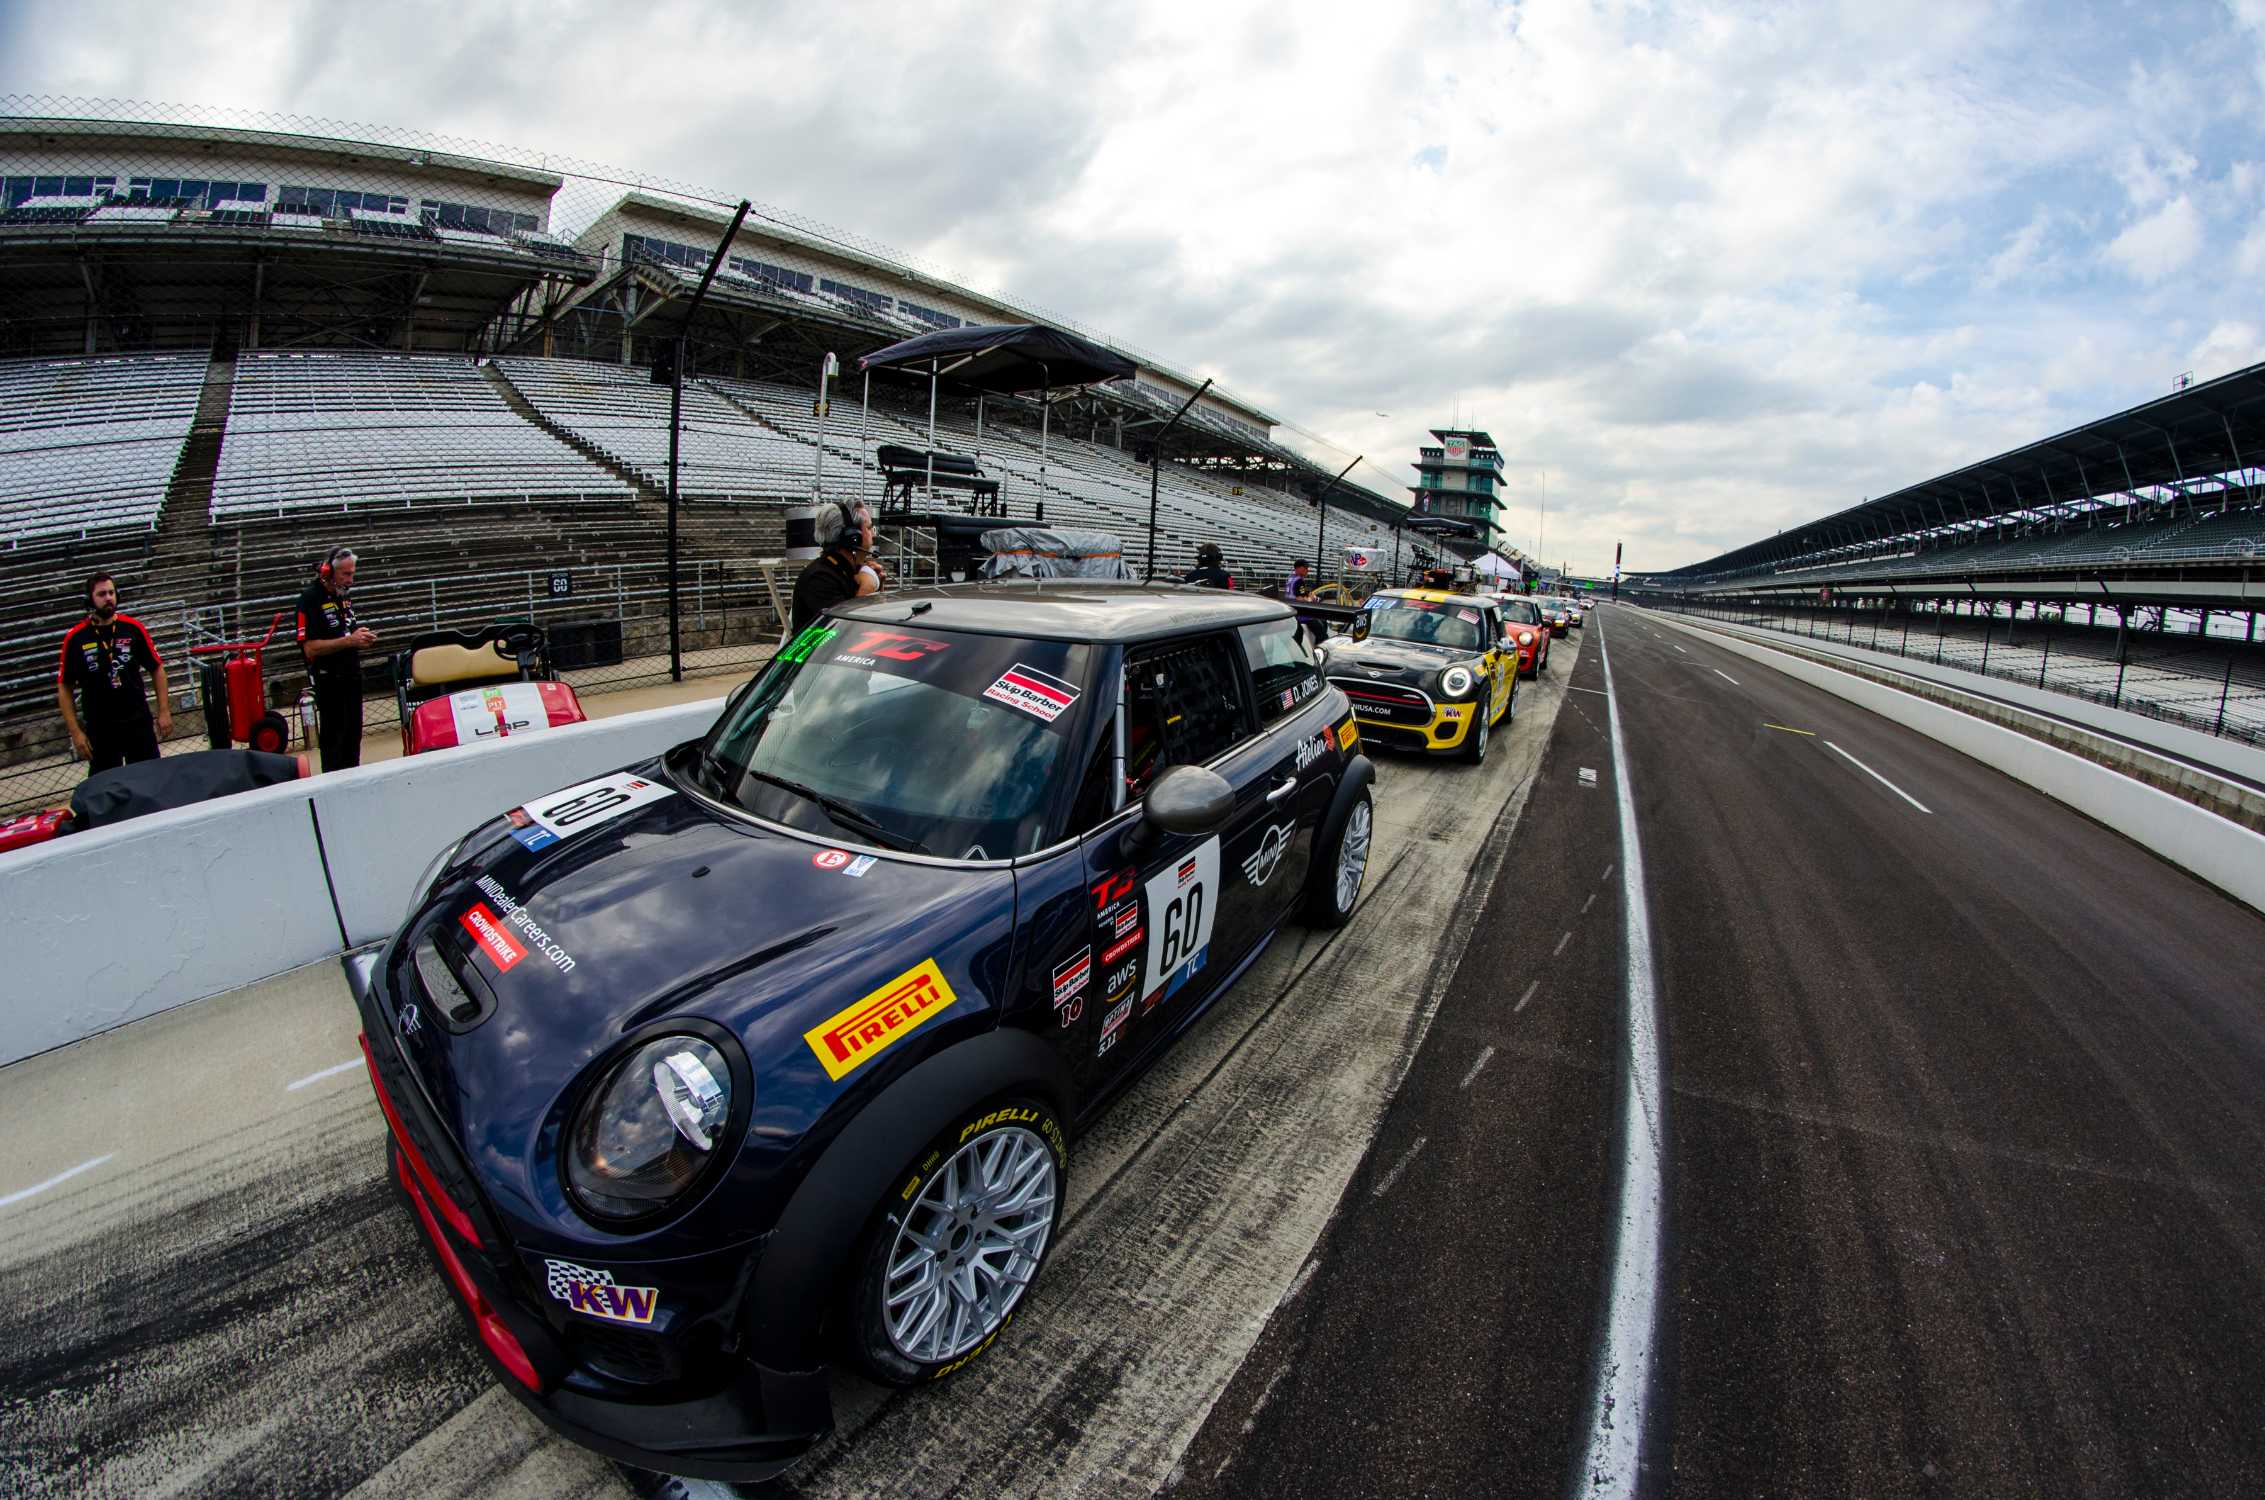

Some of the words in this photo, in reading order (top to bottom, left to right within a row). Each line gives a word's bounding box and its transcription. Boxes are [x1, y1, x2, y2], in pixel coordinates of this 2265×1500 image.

[553, 578, 568, 592] 60
[834, 654, 876, 667] AMERICA
[847, 631, 951, 661] TC
[995, 680, 1021, 695] Skip
[1021, 690, 1063, 712] Barber
[1301, 674, 1319, 698] JONES
[987, 688, 1020, 705] Racing
[1022, 702, 1056, 720] School
[1295, 735, 1329, 772] Atelier
[542, 787, 632, 827] 60
[524, 830, 552, 846] TC
[1259, 842, 1278, 870] MINI
[475, 874, 576, 973] MINIDealerCareers.com
[1097, 901, 1121, 920] AMERICA
[468, 911, 518, 963] CROWDSTRIKE
[1160, 881, 1203, 977] 60
[1104, 931, 1141, 961] CROWDSTRIKE
[1107, 958, 1137, 994] aws
[1186, 952, 1200, 980] TC
[822, 973, 941, 1063] PIRELLI
[959, 1107, 1040, 1144] PIRELLI
[568, 1280, 657, 1320] KW
